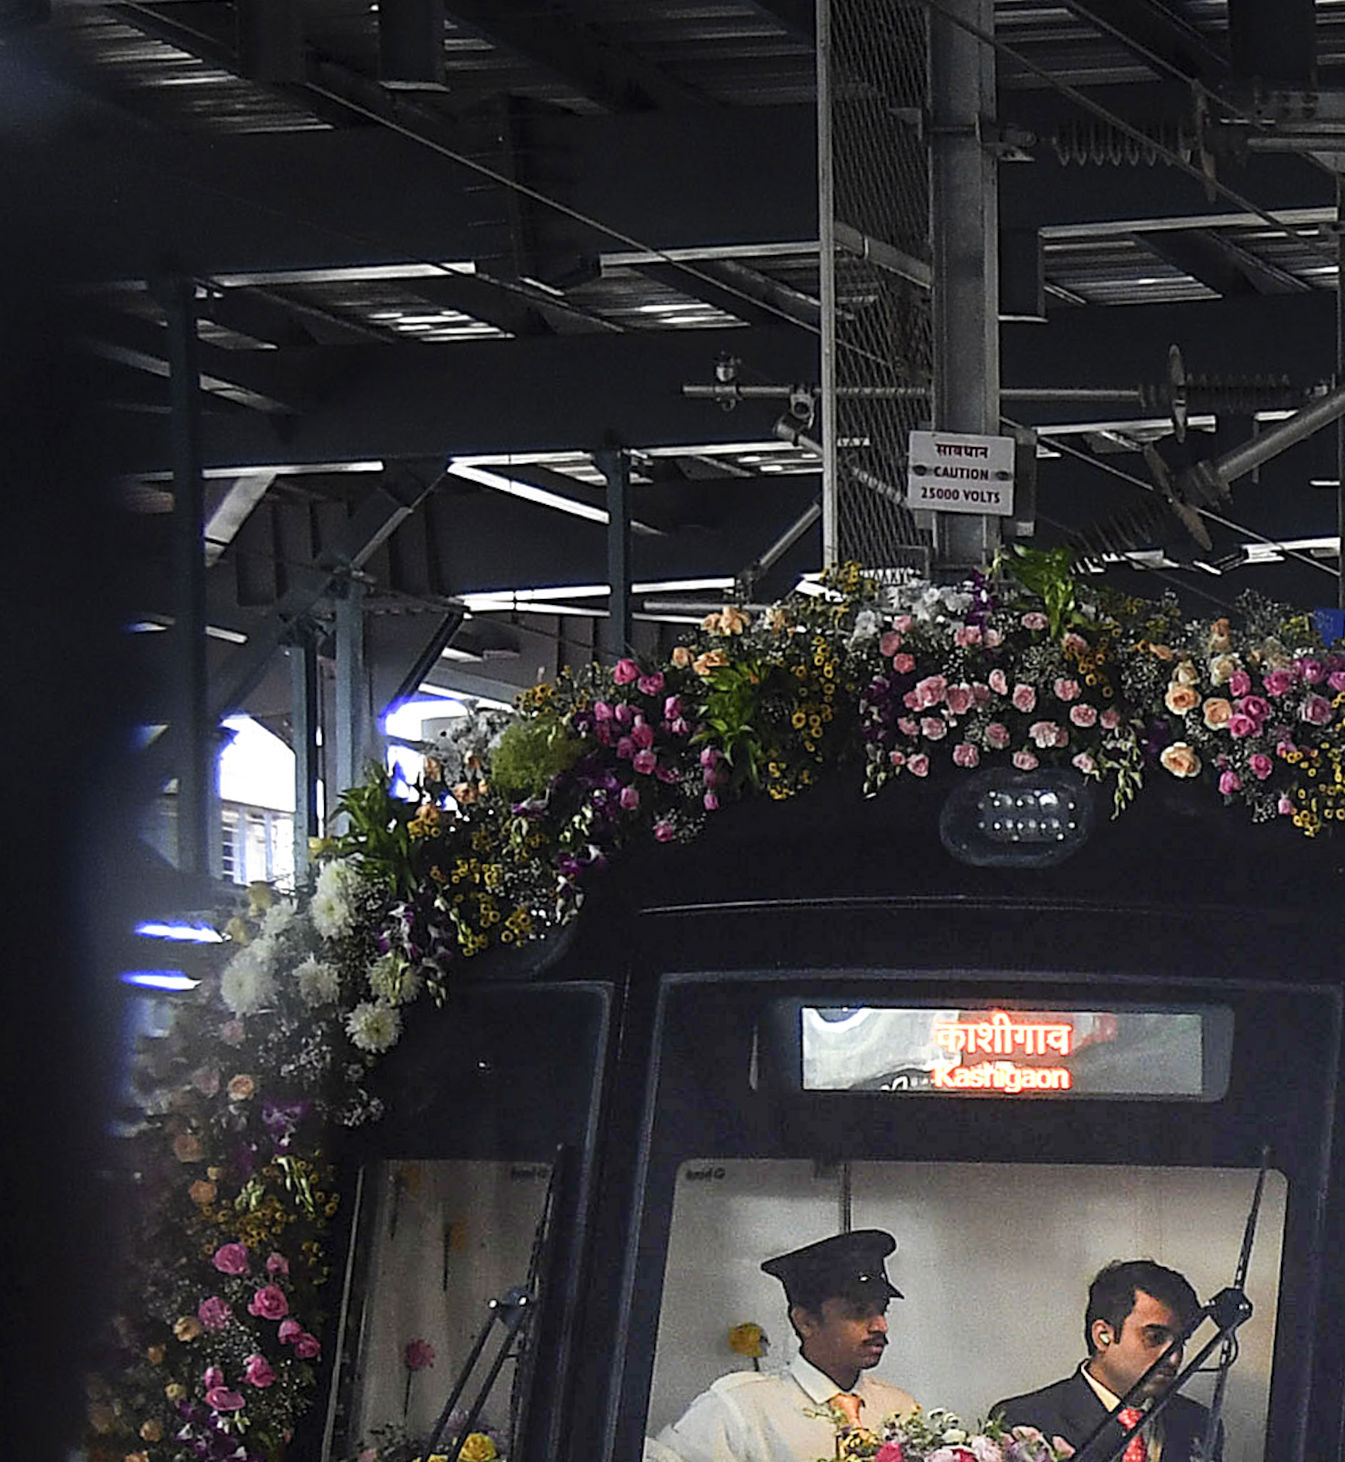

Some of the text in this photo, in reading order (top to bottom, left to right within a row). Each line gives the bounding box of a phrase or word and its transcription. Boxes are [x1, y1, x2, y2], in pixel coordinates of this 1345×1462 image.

[935, 443, 988, 459] सावधान
[934, 466, 989, 480] CAUTION
[921, 487, 1000, 504] 25000 VOLTS
[933, 1062, 1071, 1094] Kashigaon
